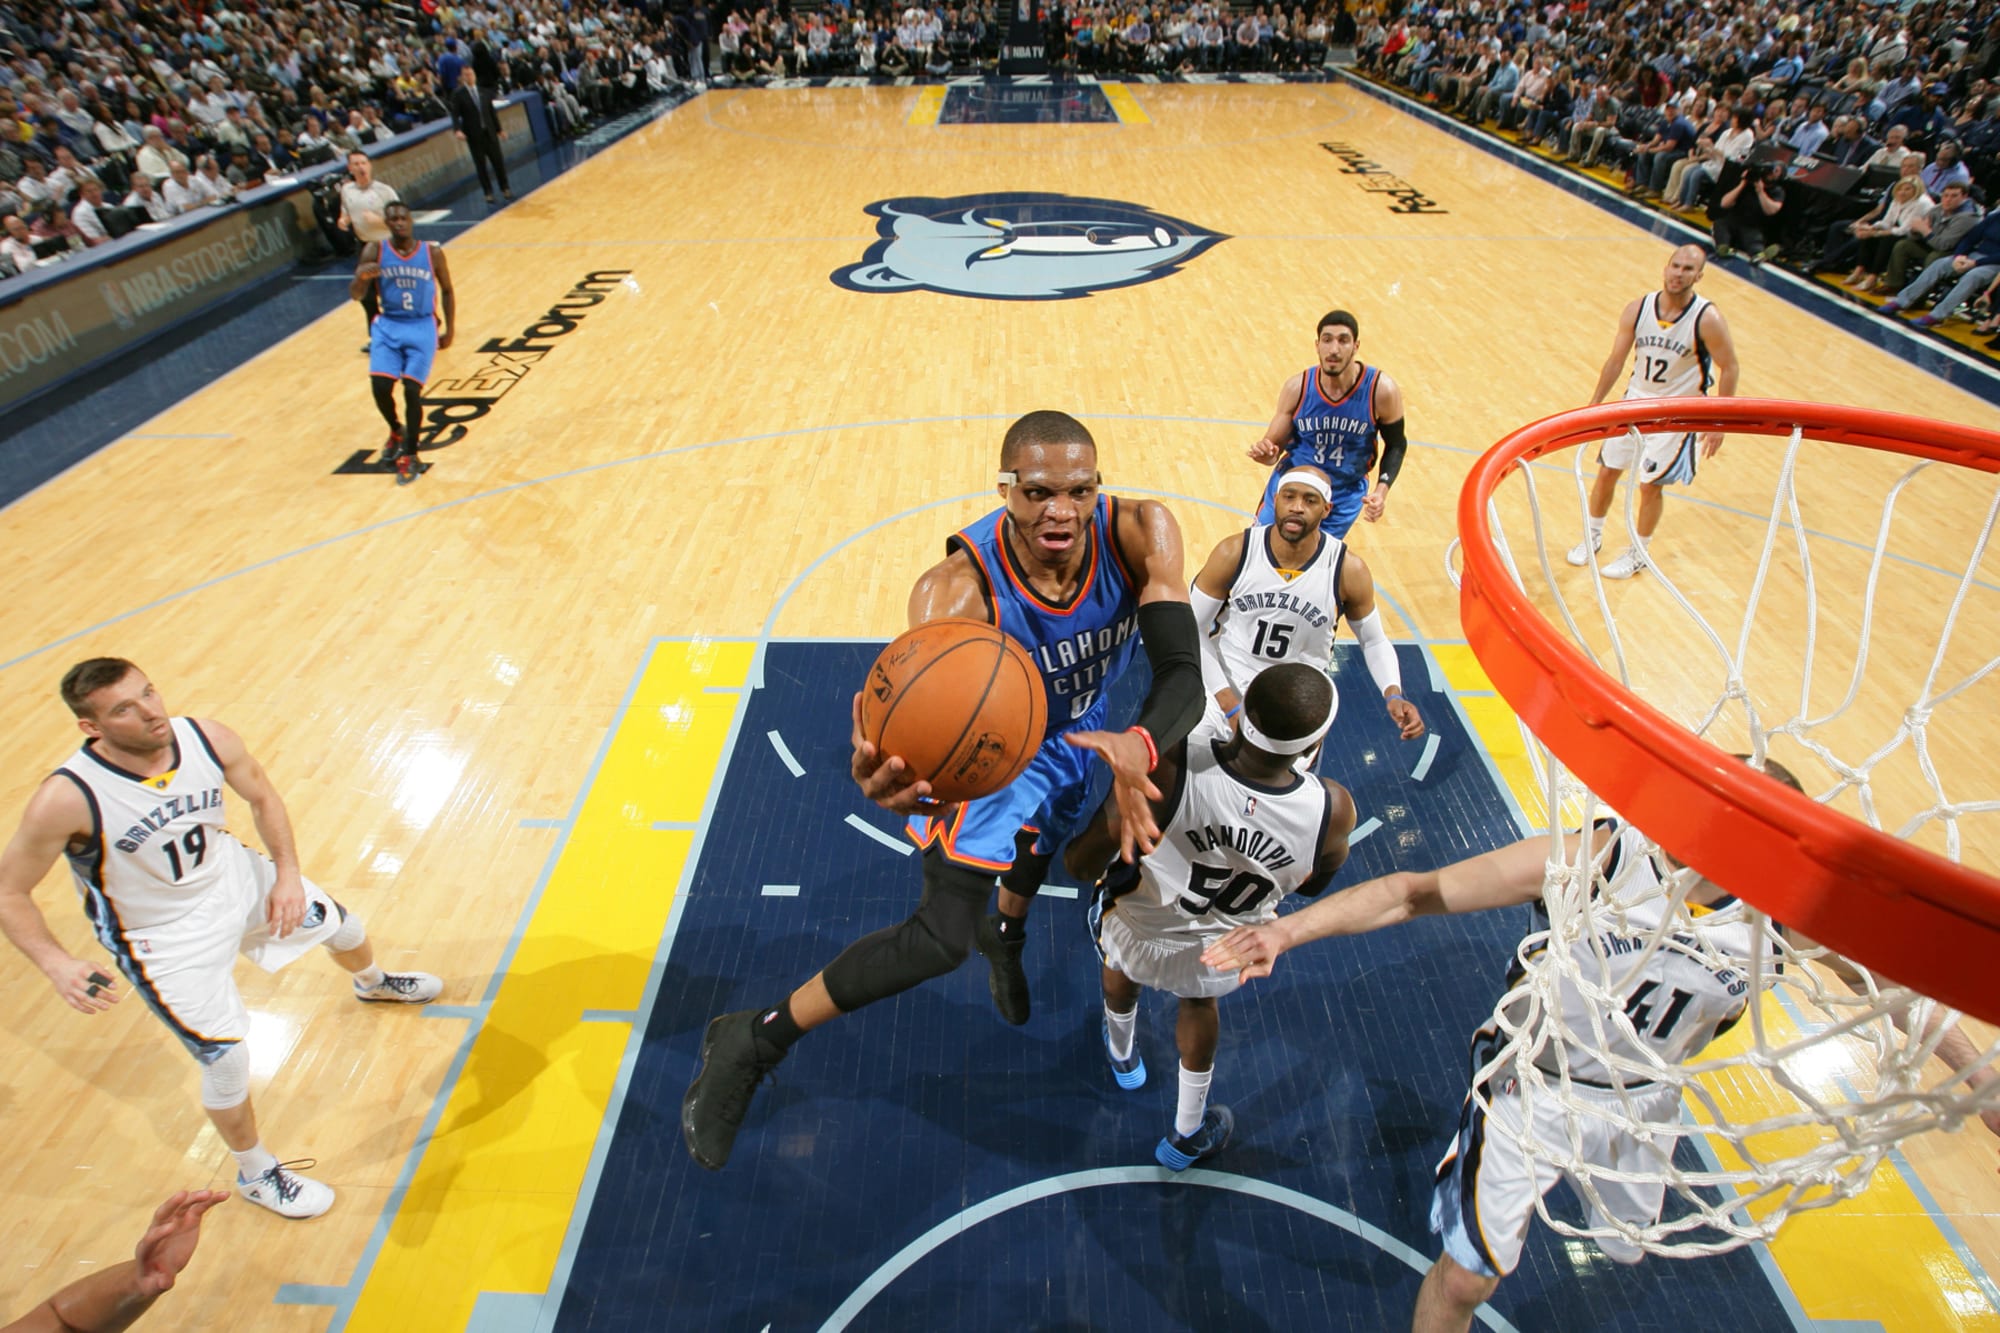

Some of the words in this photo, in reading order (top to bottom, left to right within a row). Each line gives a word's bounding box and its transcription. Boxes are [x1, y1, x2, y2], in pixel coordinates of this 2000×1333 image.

[1012, 46, 1031, 58] NBA
[1032, 46, 1045, 58] TV
[120, 216, 291, 317] NBASTORE.COM
[395, 278, 417, 289] CITY
[402, 291, 414, 311] 2
[0, 309, 79, 382] .COM
[1645, 355, 1668, 383] 12
[1297, 416, 1369, 435] OKLAHOMA
[1316, 432, 1345, 445] CITY
[1313, 444, 1345, 467] 34
[1234, 592, 1329, 628] GRIZZLIES
[1251, 619, 1295, 659] 15
[1053, 655, 1111, 695] CITY
[1070, 688, 1097, 720] 0
[114, 788, 223, 854] GRIZZLIE
[161, 823, 207, 882] 19
[1185, 825, 1296, 872] RANDOLPH
[1179, 861, 1276, 916] 50
[1607, 979, 1694, 1039] 41
